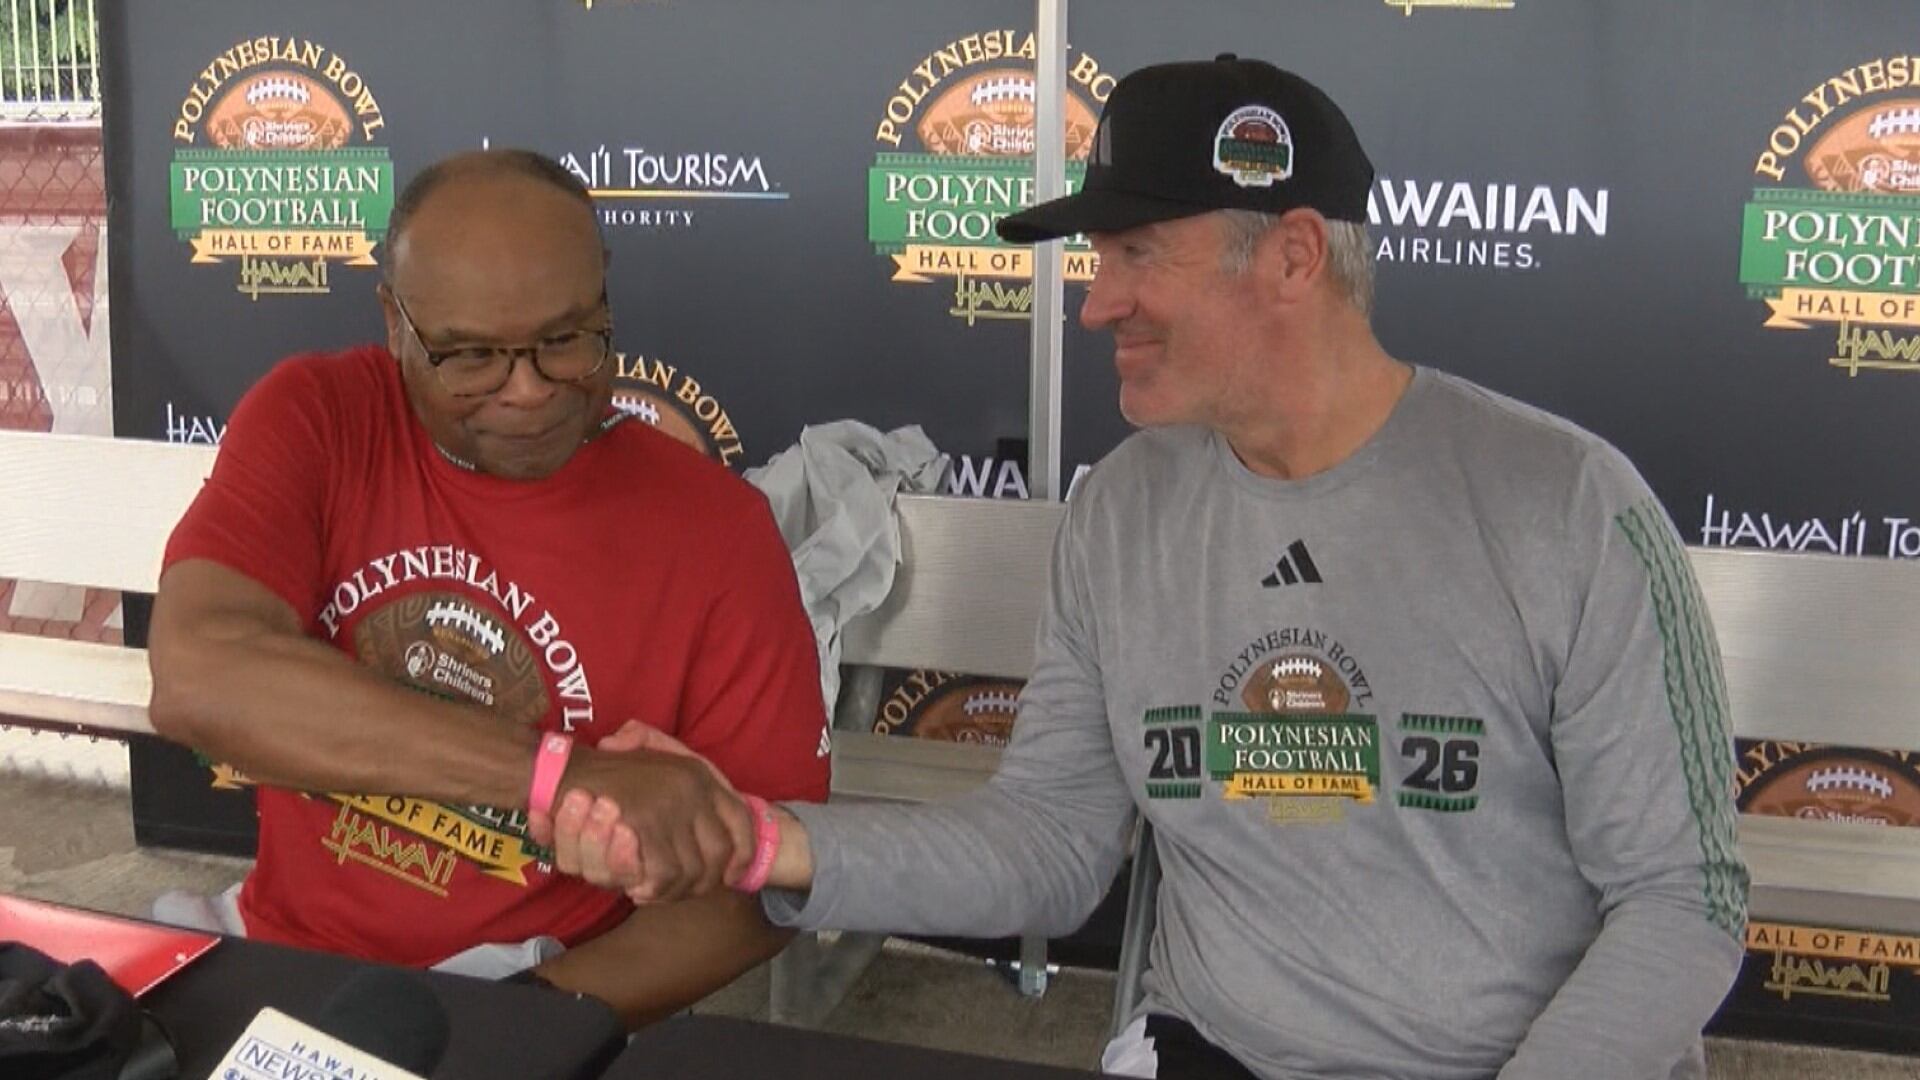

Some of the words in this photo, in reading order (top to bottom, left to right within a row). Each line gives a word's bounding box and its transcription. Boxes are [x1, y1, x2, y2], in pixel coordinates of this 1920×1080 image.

[174, 36, 324, 143] POLYNESIAN
[323, 55, 384, 141] BOWL
[876, 30, 1071, 146] POLYNESIA
[1069, 53, 1117, 103] BO
[1756, 55, 1920, 181] POLYNESI
[184, 166, 380, 194] POLYNESIAN
[623, 148, 770, 191] TOURISM
[886, 172, 1074, 207] POLYNE
[1366, 179, 1608, 236] WAIIAN
[200, 197, 367, 228] FOOTBALL
[597, 210, 695, 226] HORITY
[1762, 209, 1920, 248] POLYN
[211, 235, 258, 250] HALL
[268, 235, 292, 250] OF
[302, 235, 355, 250] FAME
[919, 253, 978, 270] HALL
[991, 255, 1021, 270] OF
[1784, 249, 1920, 287] FOOT
[1797, 294, 1865, 316] HALL
[1880, 300, 1915, 318] OF
[675, 375, 743, 467] BOWL
[319, 544, 535, 638] POLYNESIAN
[525, 610, 593, 731] BOWL
[437, 652, 493, 689] Shriners
[1214, 628, 1328, 706] POLYNESIAN
[1327, 640, 1373, 707] BOWL
[433, 668, 494, 706] Children's
[1144, 726, 1201, 780] 20
[1220, 723, 1372, 747] POLYNESIAN
[1235, 750, 1367, 772] FOOTBALL
[1401, 736, 1480, 793] 26
[1243, 777, 1285, 790] HALL
[1294, 777, 1313, 790] OF
[1322, 778, 1361, 791] FAME
[385, 796, 423, 822] OF
[432, 812, 505, 859] FAME
[1812, 933, 1846, 951] OF
[1858, 937, 1920, 958] FAM
